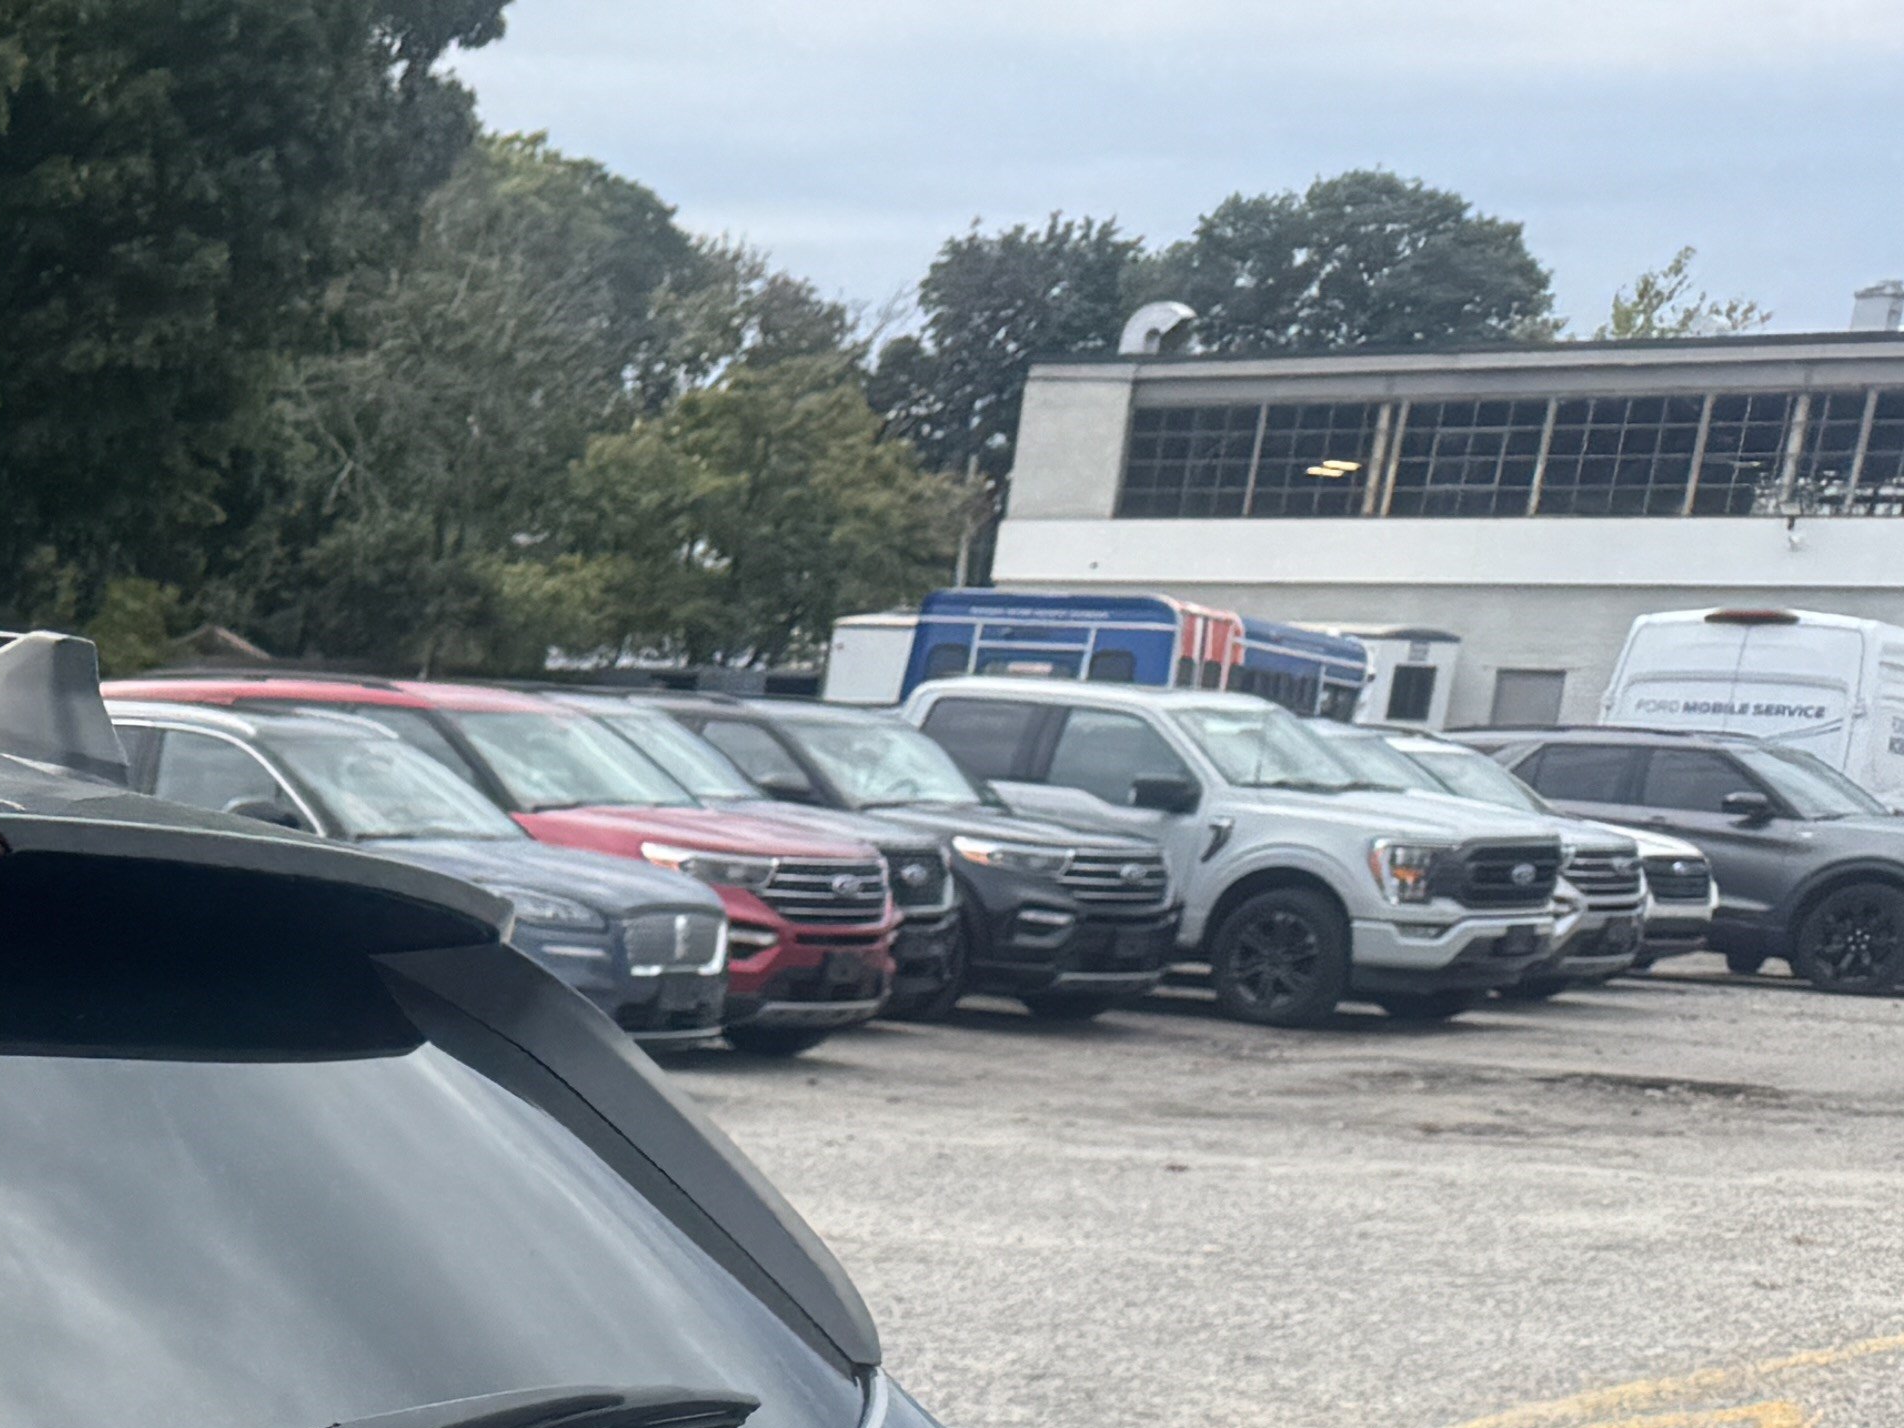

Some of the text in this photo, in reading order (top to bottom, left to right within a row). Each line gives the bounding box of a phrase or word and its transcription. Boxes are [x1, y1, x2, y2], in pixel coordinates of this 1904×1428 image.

[1635, 698, 1826, 719] FORD MOBILE SERVICE
